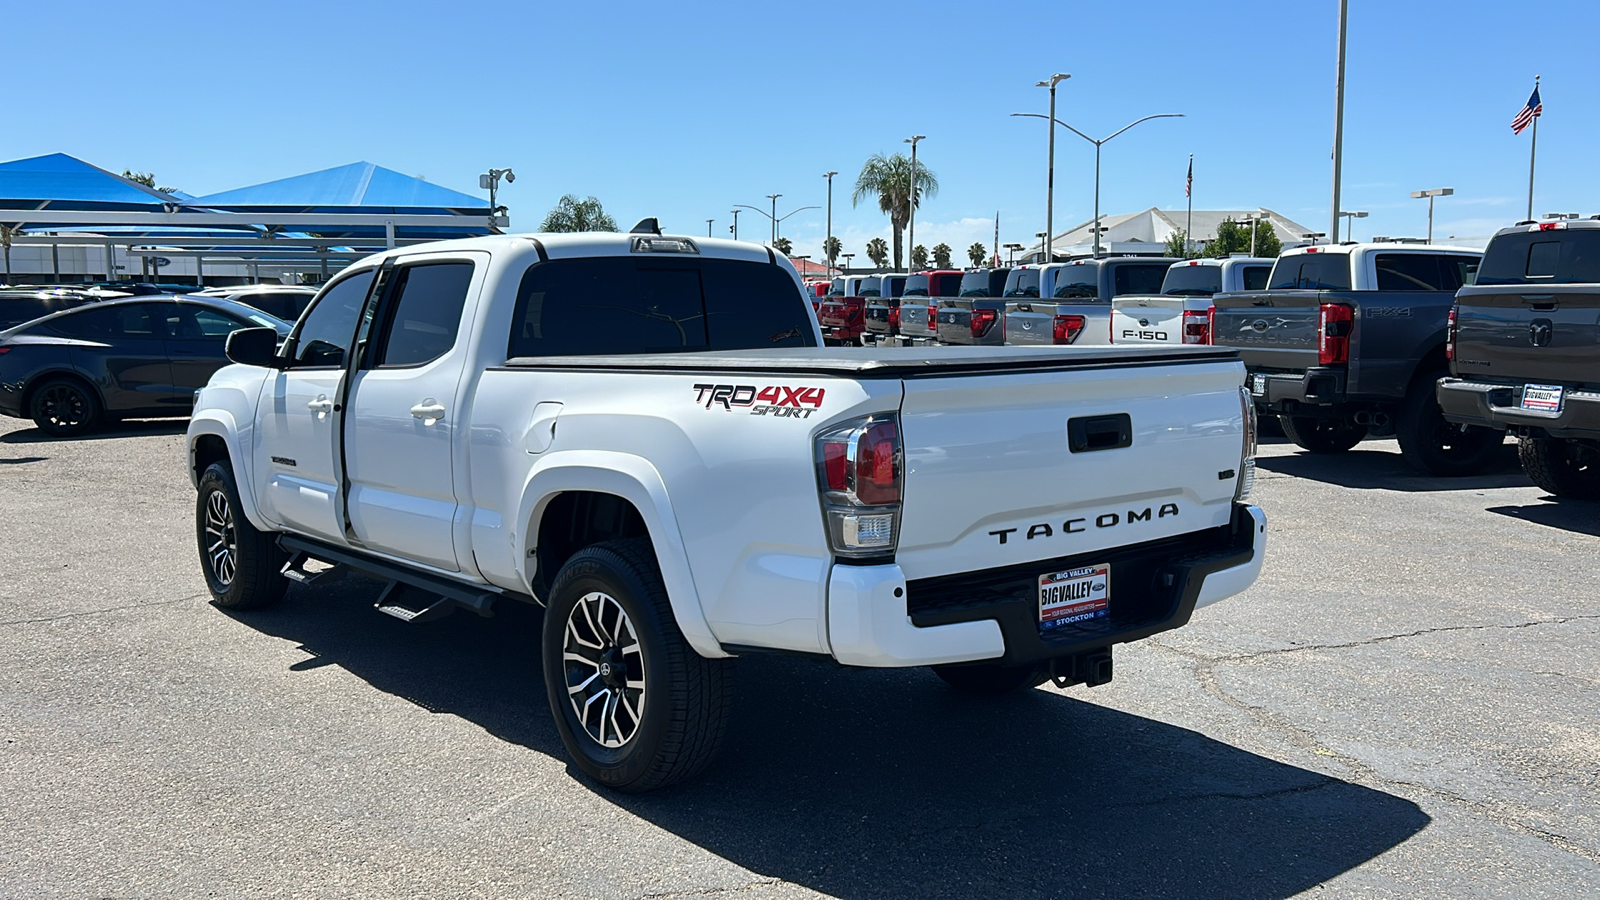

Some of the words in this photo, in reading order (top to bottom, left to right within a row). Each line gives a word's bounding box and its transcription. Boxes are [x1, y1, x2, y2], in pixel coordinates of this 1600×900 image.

[1366, 306, 1414, 319] FX4
[1122, 330, 1168, 341] F-150
[693, 383, 757, 412] TRD
[756, 386, 826, 408] 4X4
[750, 405, 818, 419] SPORT
[988, 502, 1180, 545] TACOMA
[1056, 572, 1068, 580] BIG
[1069, 567, 1093, 577] VALLEY
[1042, 581, 1093, 605] BIGVALLEY
[1056, 612, 1095, 626] STOCKTON
